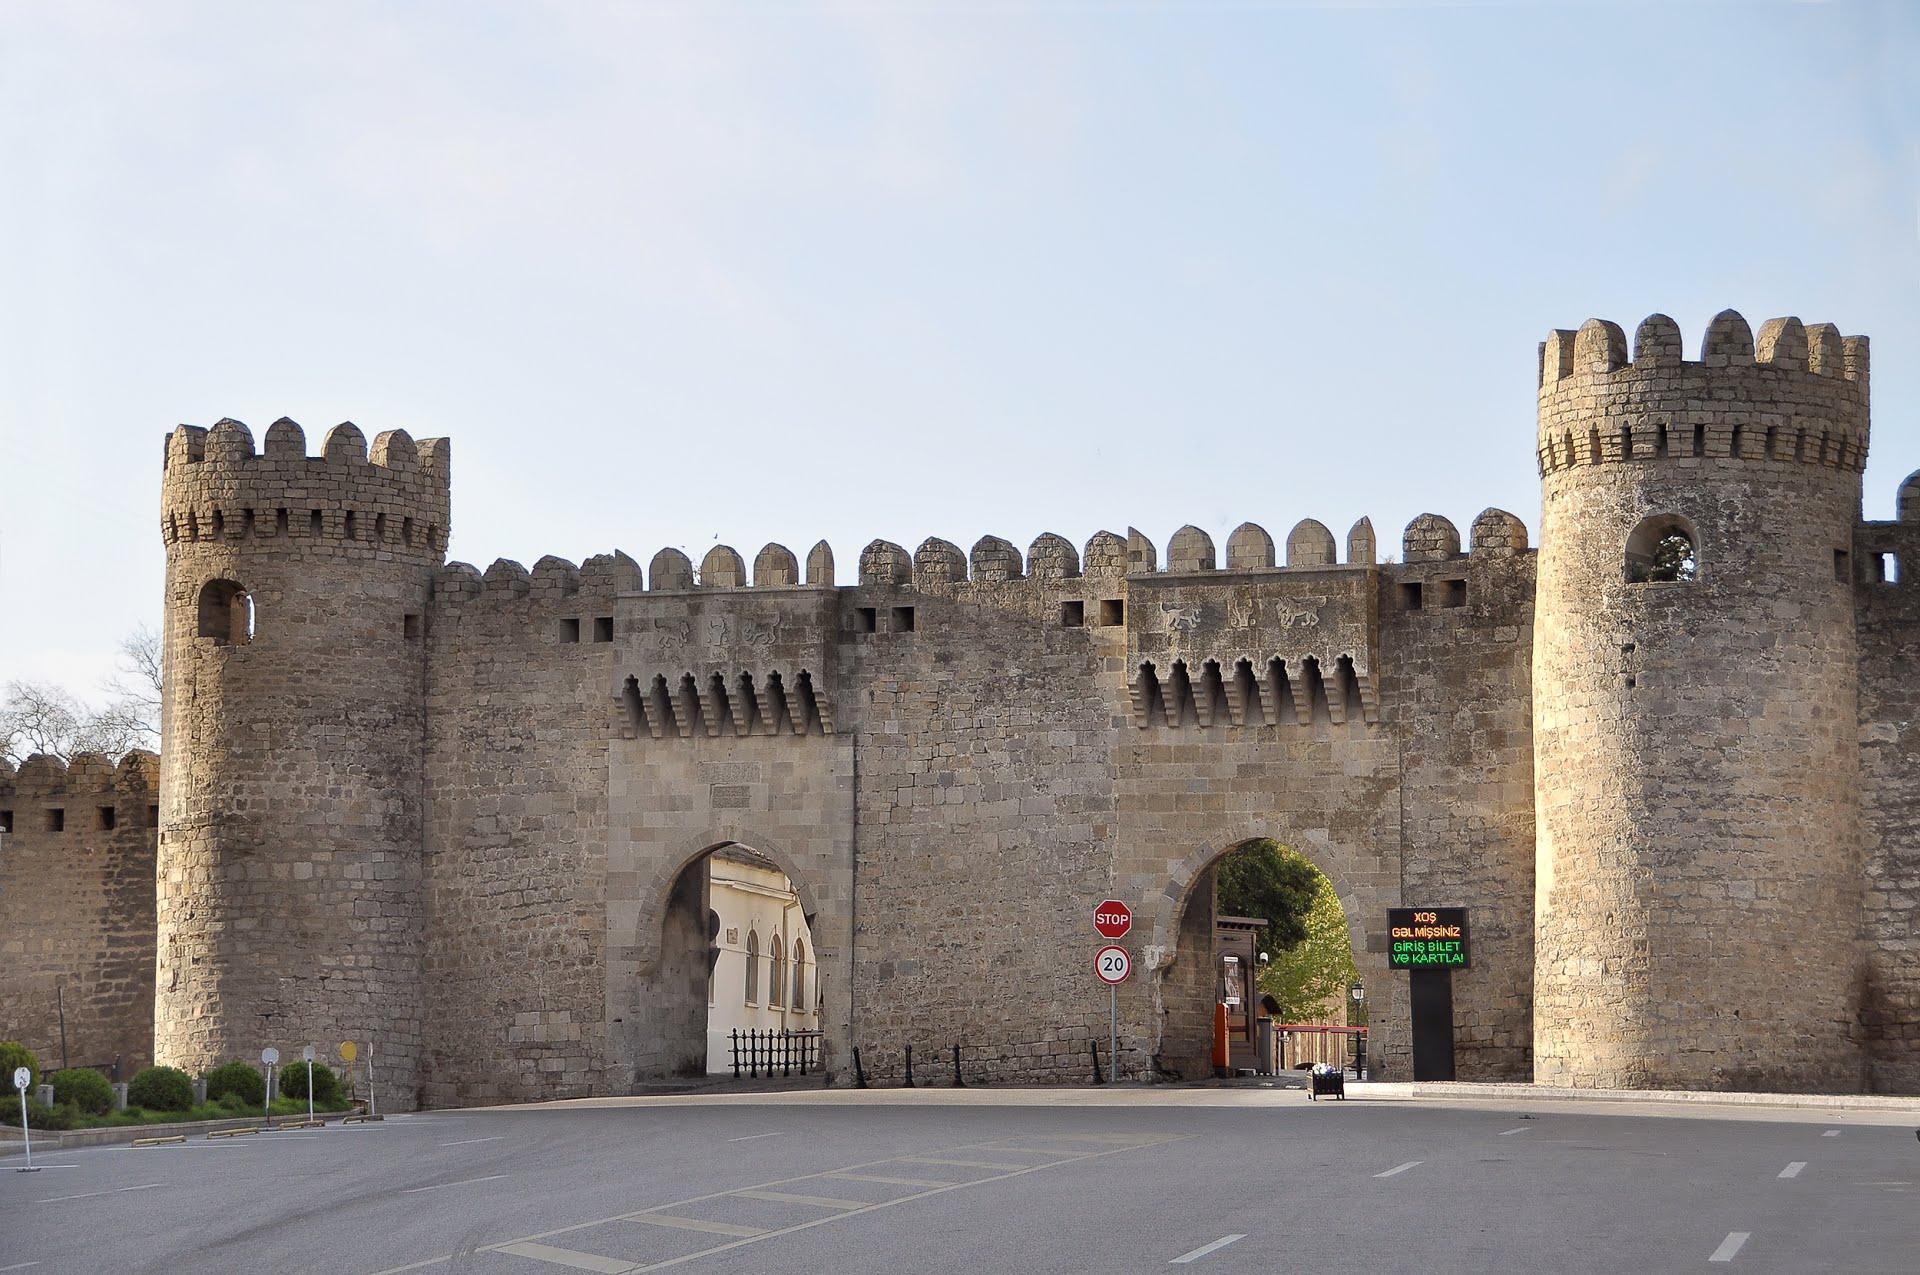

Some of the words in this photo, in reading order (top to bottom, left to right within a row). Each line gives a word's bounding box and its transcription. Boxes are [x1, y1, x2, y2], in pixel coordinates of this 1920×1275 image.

[1096, 913, 1129, 925] STOP
[1414, 912, 1437, 924] XOŞ
[1393, 940, 1425, 954] GİRİŞ
[1428, 940, 1461, 952] BİLET
[1392, 953, 1410, 963] VƏ
[1413, 953, 1464, 963] KARTLA!
[1103, 957, 1124, 972] 20
